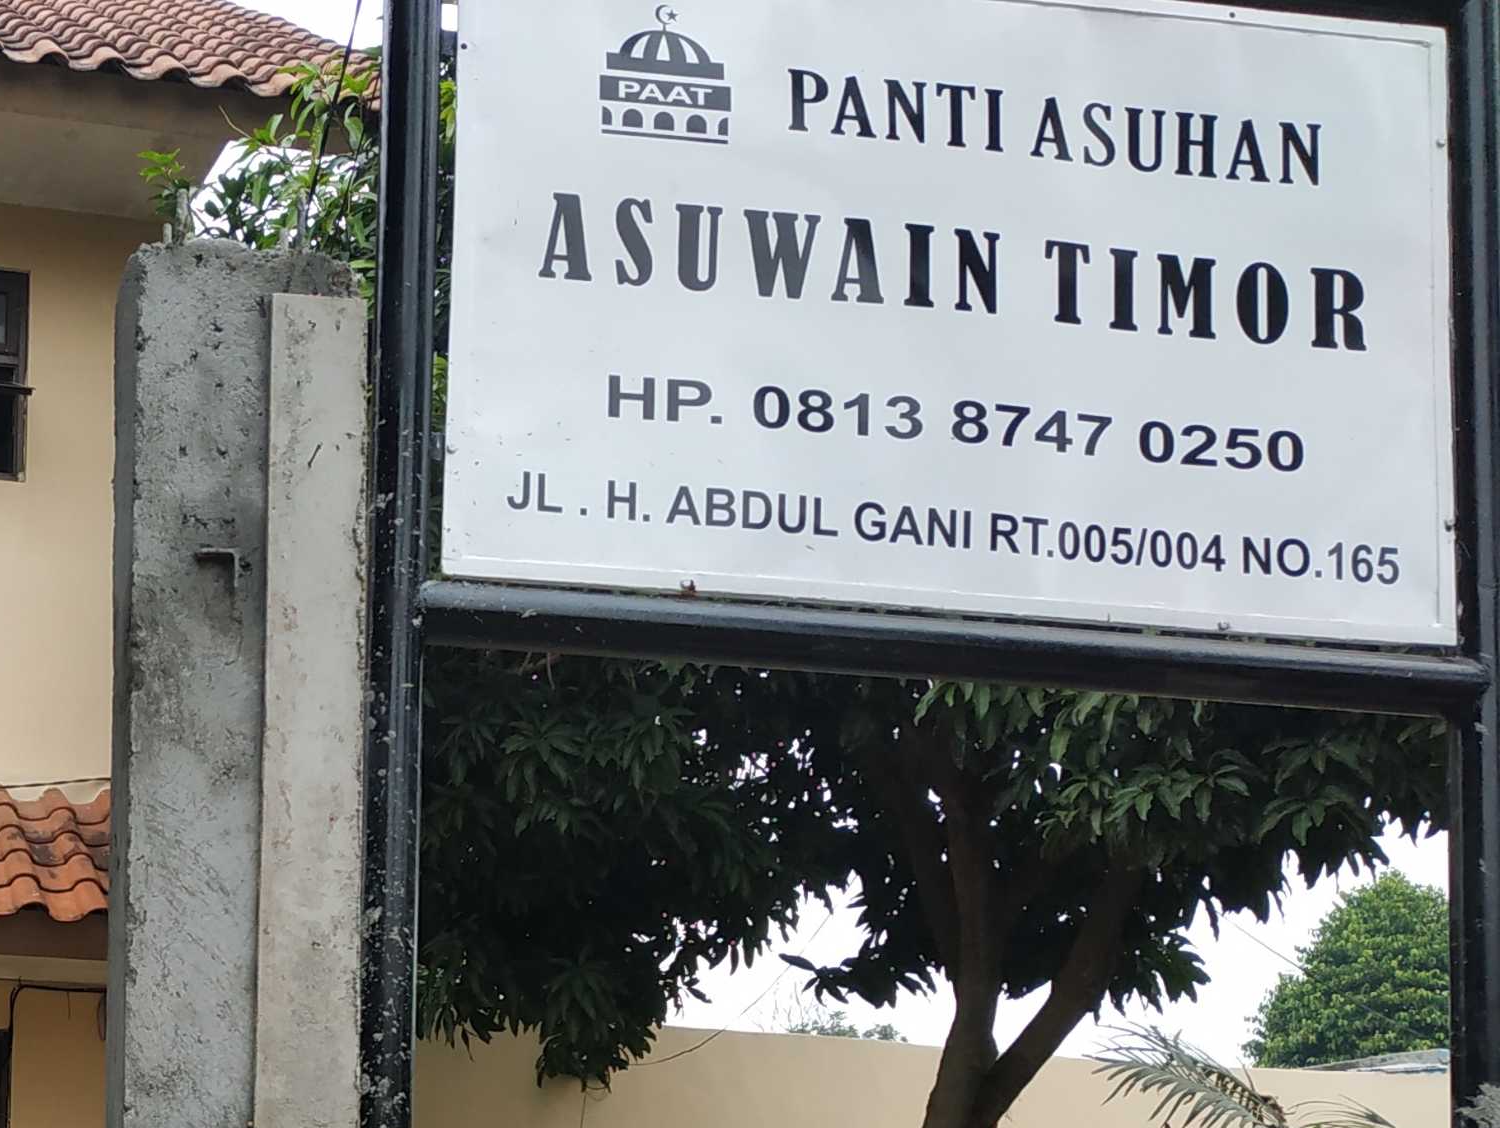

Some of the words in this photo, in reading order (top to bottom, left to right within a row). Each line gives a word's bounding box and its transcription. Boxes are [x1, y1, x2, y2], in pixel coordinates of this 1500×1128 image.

[617, 80, 713, 106] PAAT
[787, 68, 1004, 153] PANTI
[1030, 96, 1322, 187] ASUHAN
[538, 192, 1001, 315] ASUWAIN
[1044, 239, 1367, 353] TIMOR
[608, 375, 722, 425] HP.
[753, 385, 923, 440] 0813
[951, 400, 1113, 456] 8747
[1139, 420, 1304, 473] 0250
[607, 480, 650, 522] H.
[666, 486, 839, 537] ABDUL
[854, 501, 972, 549] GANI
[990, 512, 1226, 572] RT.005/004
[1242, 536, 1400, 584] NO.165
